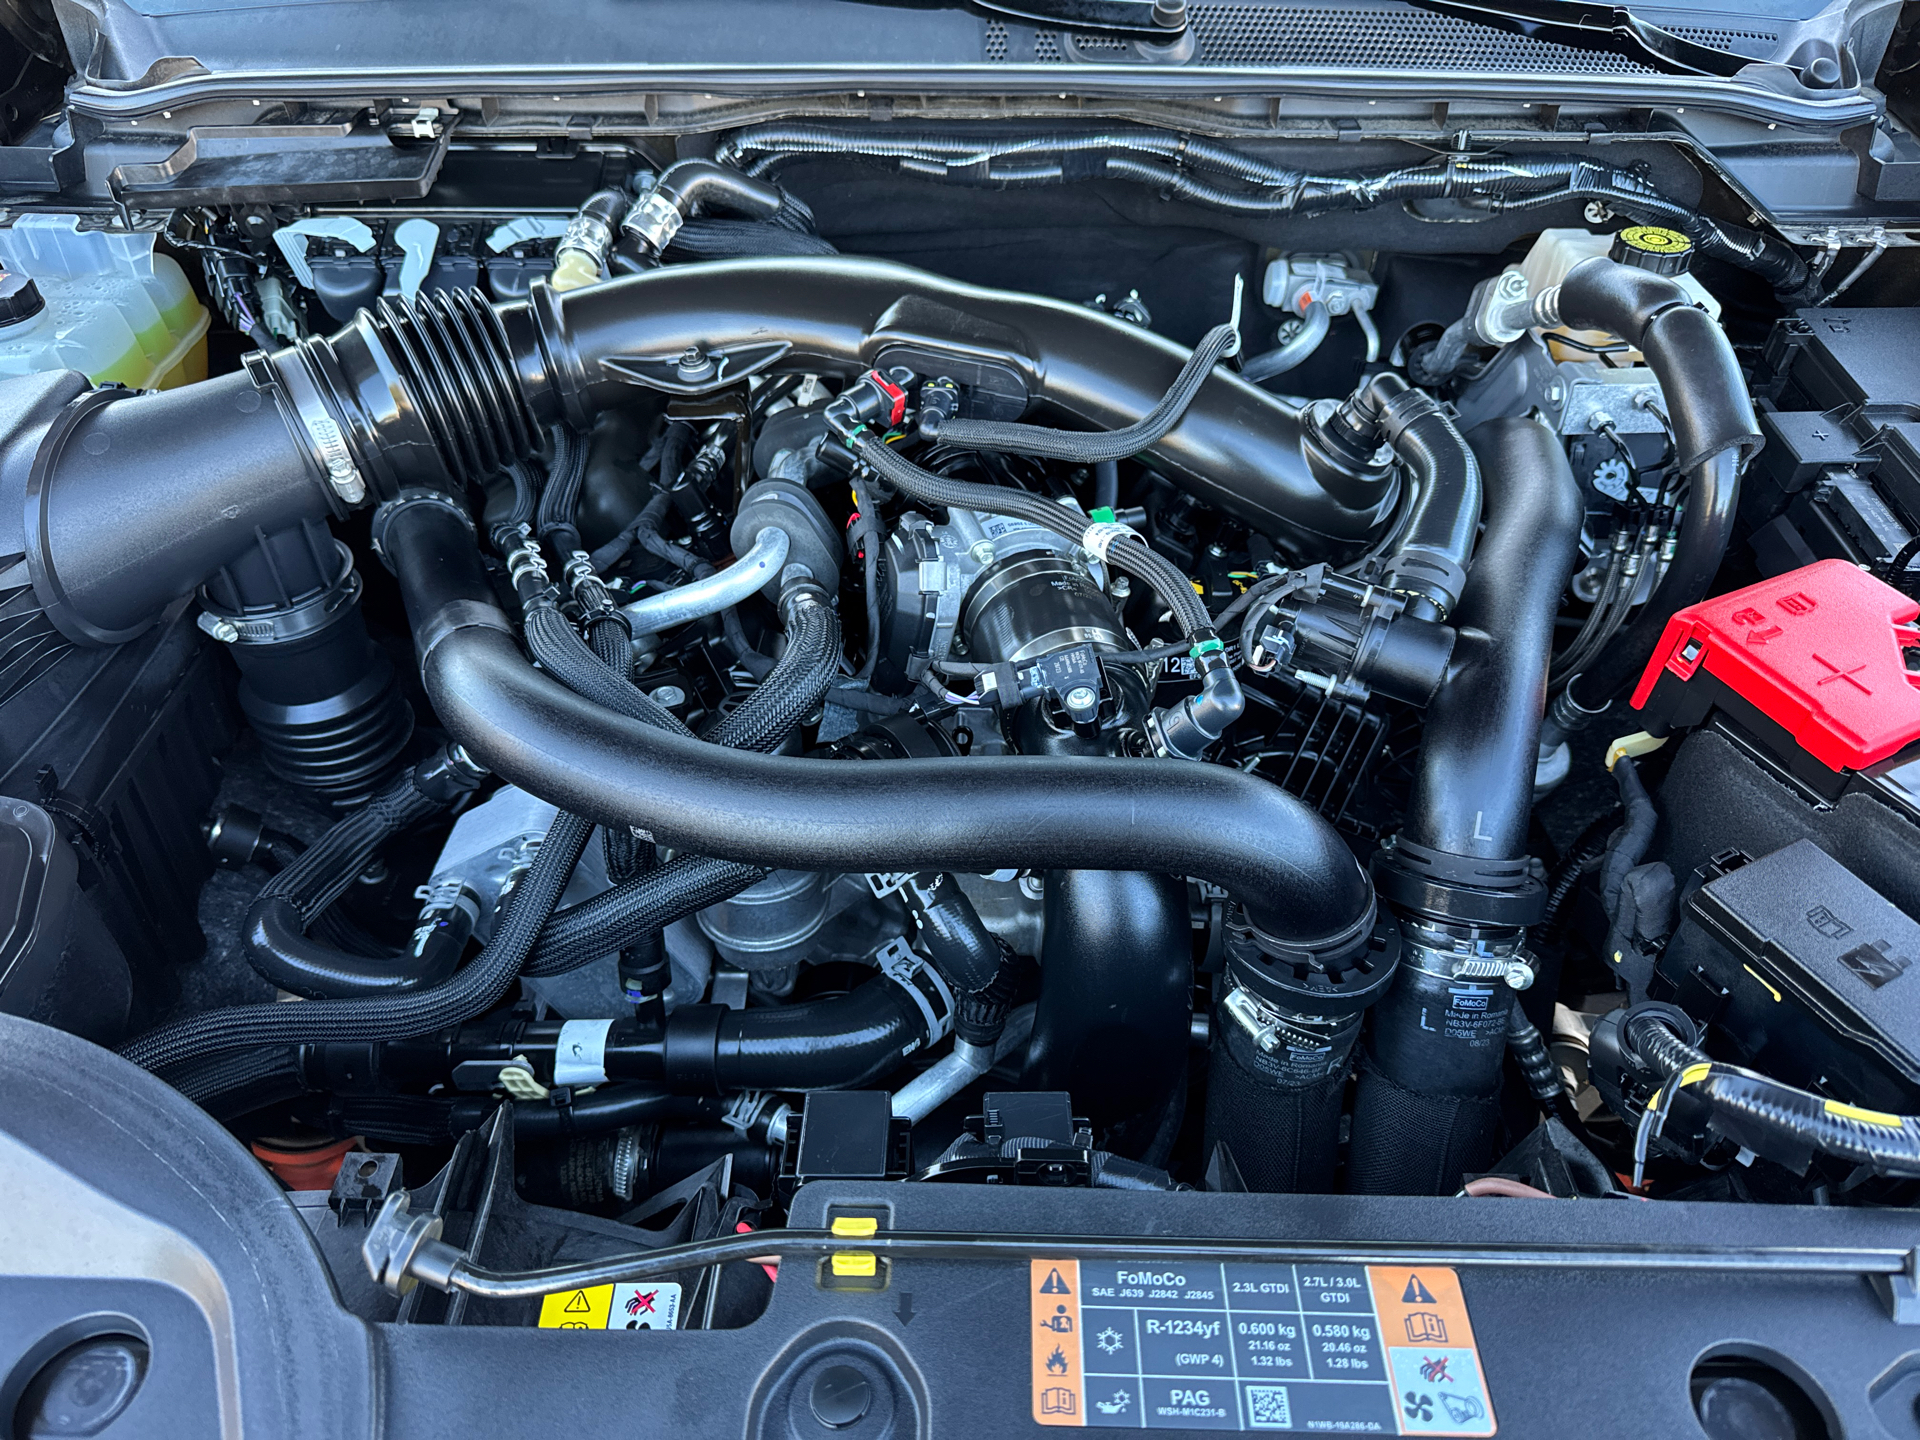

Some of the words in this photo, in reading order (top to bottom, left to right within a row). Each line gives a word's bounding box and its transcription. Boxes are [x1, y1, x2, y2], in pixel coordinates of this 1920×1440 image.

[1163, 657, 1181, 673] 12
[1473, 810, 1493, 842] L
[1453, 998, 1486, 1007] FoMoCo
[1444, 1008, 1470, 1019] Made
[1471, 1011, 1479, 1019] in
[1255, 1049, 1279, 1064] Made
[1116, 1270, 1187, 1286] FoMoCo
[1303, 1276, 1329, 1288] 2.7L
[1335, 1277, 1362, 1288] 3.0L
[1091, 1287, 1116, 1298] SAE
[1118, 1288, 1145, 1298] J639
[1148, 1289, 1179, 1299] J2842
[1183, 1290, 1215, 1300] J2845
[1232, 1282, 1259, 1293] 2.3L
[1260, 1283, 1290, 1294] GTDI
[1320, 1292, 1351, 1303] GTDI
[1146, 1318, 1221, 1340] R-1234yf
[1237, 1322, 1276, 1336] 0.600
[1278, 1323, 1297, 1339] kg
[1312, 1323, 1350, 1338] 0.580
[1351, 1325, 1371, 1341] kg
[1247, 1340, 1276, 1351] 21.16
[1277, 1343, 1292, 1352] oz
[1321, 1342, 1352, 1354] 20.46
[1353, 1344, 1368, 1354] oz
[1175, 1352, 1210, 1367] (GWP
[1211, 1354, 1225, 1368] 4)
[1250, 1355, 1274, 1367] 1.32
[1275, 1356, 1294, 1368] lbs
[1325, 1357, 1350, 1369] 1.28
[1350, 1358, 1370, 1370] lbs
[1170, 1389, 1211, 1407] PAG
[1157, 1406, 1228, 1418] WSH-M1C231-B
